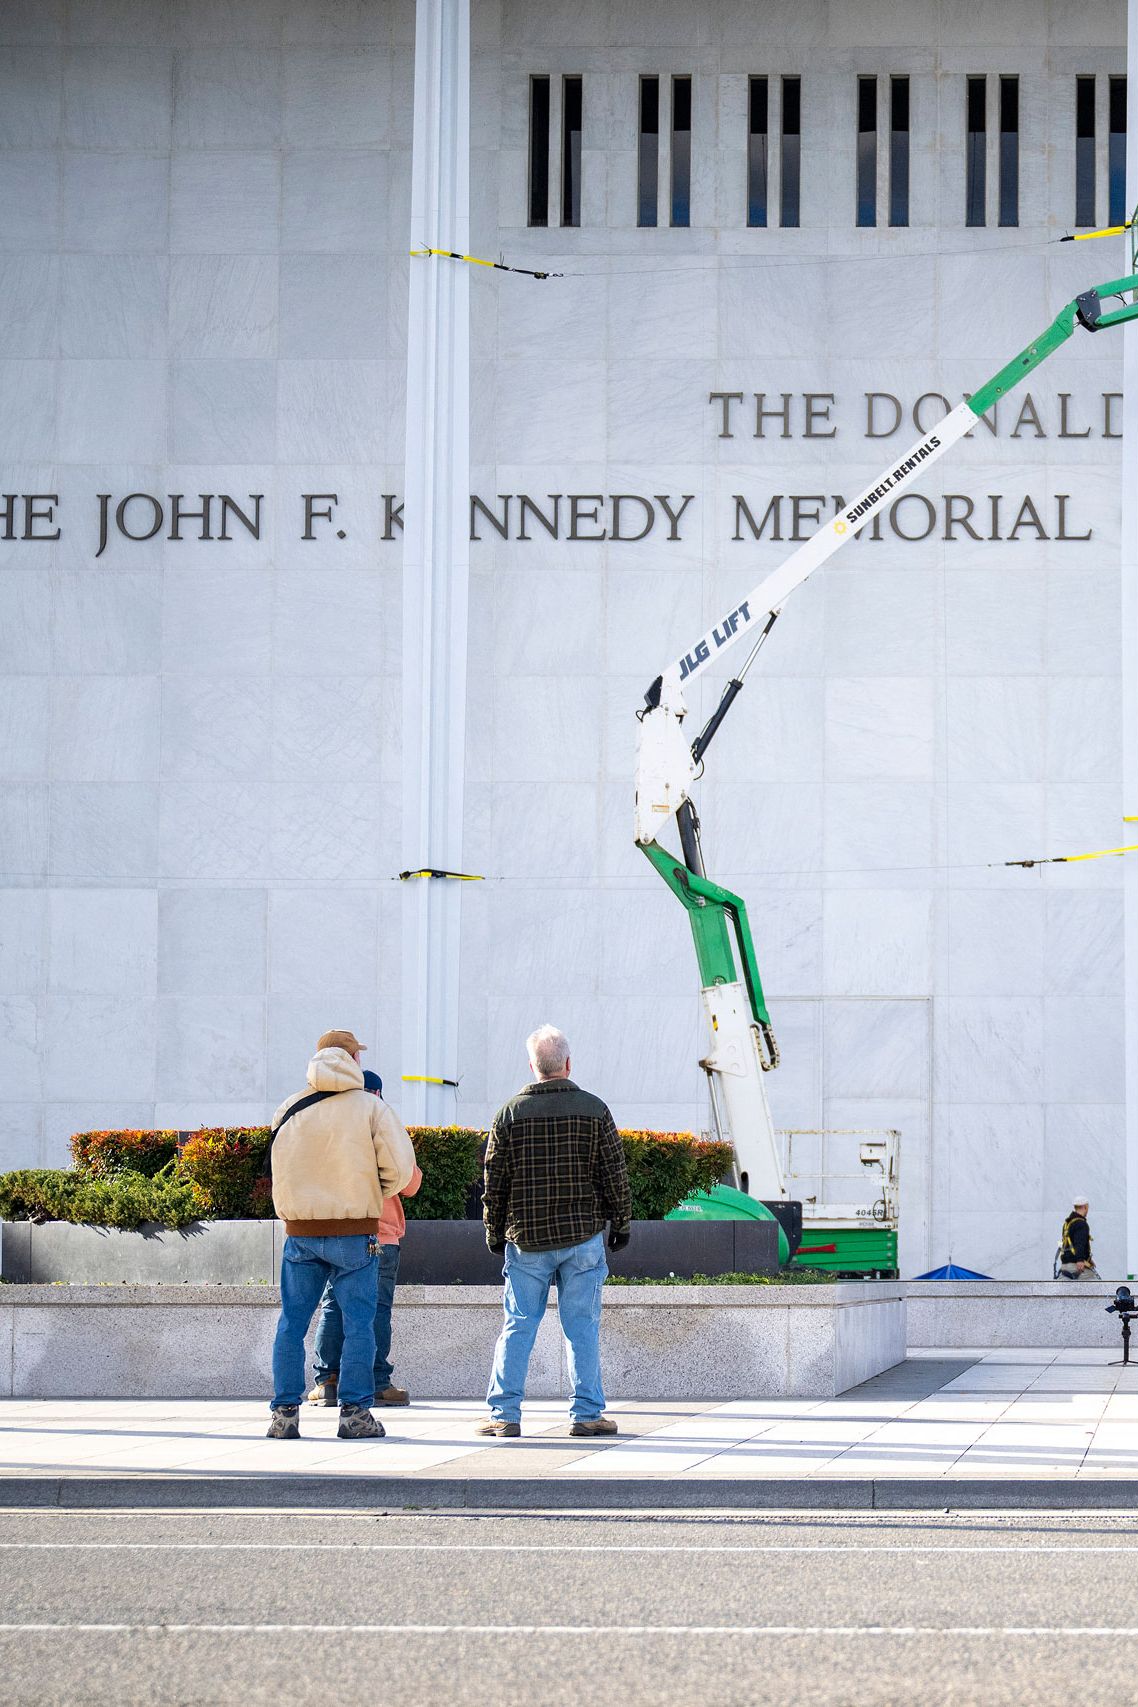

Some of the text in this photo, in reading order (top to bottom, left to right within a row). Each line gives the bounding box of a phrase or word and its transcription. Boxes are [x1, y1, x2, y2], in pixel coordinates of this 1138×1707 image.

[708, 392, 837, 440] THE
[846, 436, 941, 523] SUNBELT RENTALS
[95, 493, 265, 558] JOHN
[300, 493, 347, 541] F.
[380, 494, 696, 542] KNNEDY
[679, 600, 751, 682] JLG LIFT
